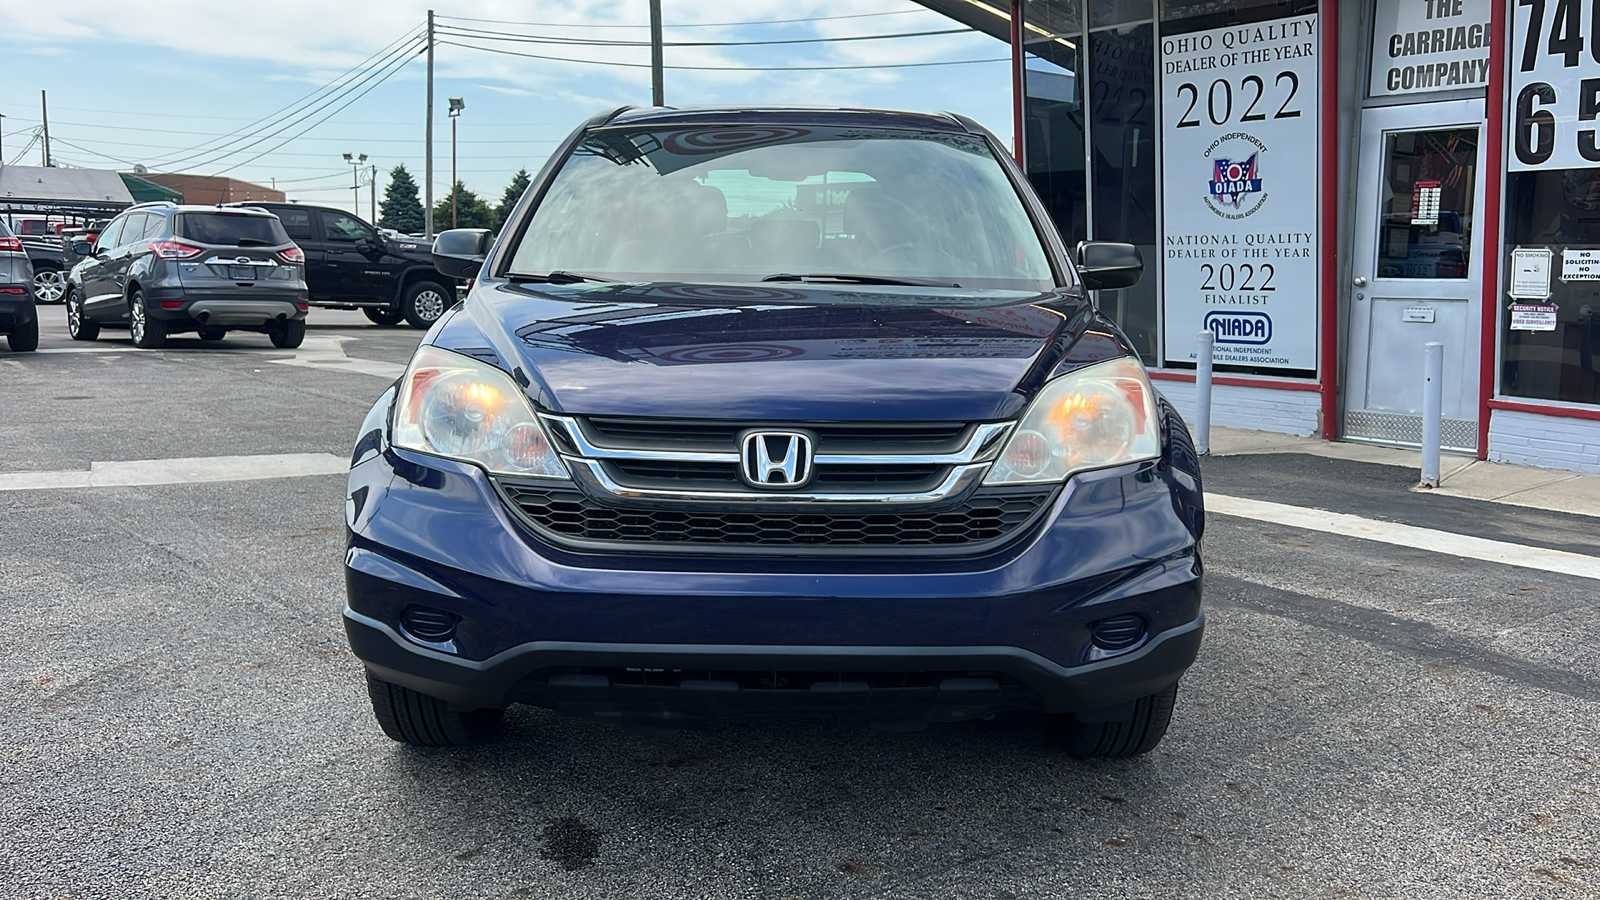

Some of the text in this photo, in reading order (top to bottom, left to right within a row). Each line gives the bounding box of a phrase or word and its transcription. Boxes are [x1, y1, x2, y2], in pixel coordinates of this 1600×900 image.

[1425, 0, 1463, 20] THE
[1163, 18, 1316, 56] OHIO QUALITY
[1518, 0, 1600, 73] 74
[1165, 55, 1217, 75] DEALER
[1220, 52, 1239, 68] OF
[1242, 48, 1271, 65] THE
[1274, 42, 1314, 61] YEAR
[1387, 58, 1490, 91] COMPANY
[1176, 70, 1301, 129] 2022
[1204, 132, 1268, 158] OHIO INDEPENDENT
[1215, 180, 1253, 193] OIADA
[1203, 196, 1225, 218] AUTOMOBILE
[1245, 192, 1268, 218] ASSOCIATION
[1166, 232, 1313, 246] NATIONAL QUALITY
[1168, 247, 1311, 259] DEALER OF THE YEAR
[1200, 263, 1276, 291] 2022
[1205, 294, 1269, 305] FINALIST
[1209, 318, 1265, 338] NIADA
[1212, 345, 1272, 355] TIONAL INDEPENDENT
[1225, 354, 1248, 362] DEALERS
[1250, 356, 1289, 364] ASSOCIATION
